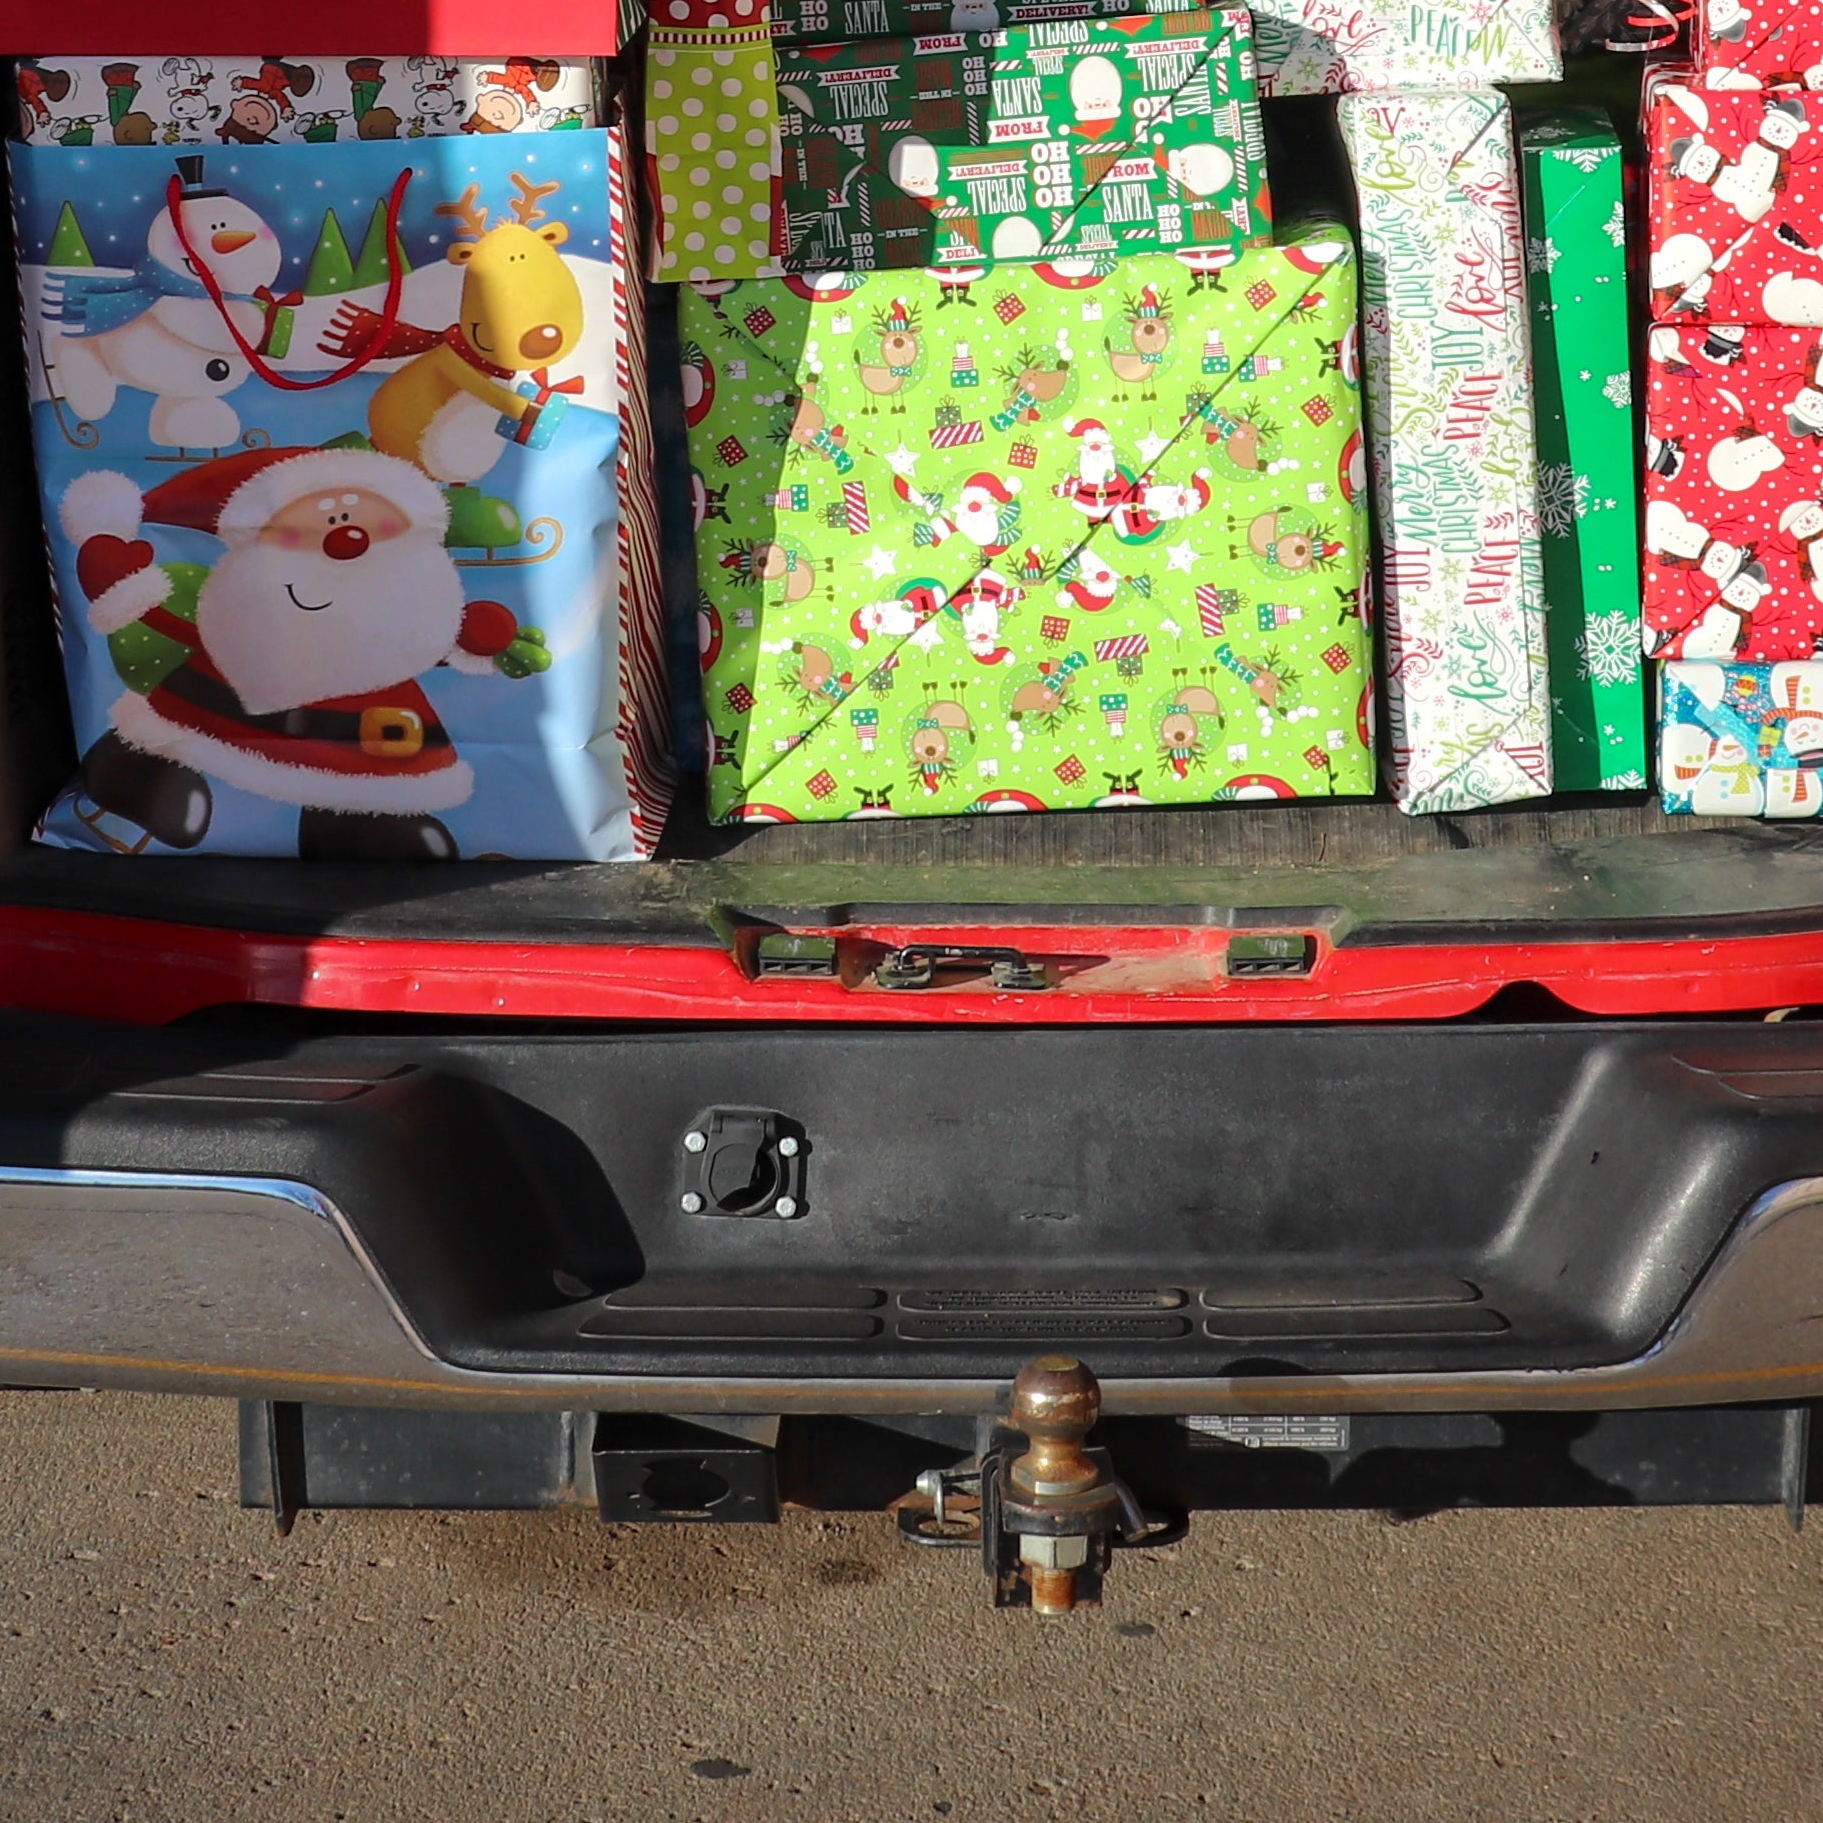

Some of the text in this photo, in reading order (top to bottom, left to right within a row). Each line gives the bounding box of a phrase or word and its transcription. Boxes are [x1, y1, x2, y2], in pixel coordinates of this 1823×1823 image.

[800, 0, 828, 16] HO
[1015, 4, 1089, 19] DELIVERY!
[801, 16, 829, 32] HO
[845, 0, 890, 35] SANTA
[919, 35, 962, 50] FROM
[979, 32, 1009, 48] HO
[1133, 40, 1201, 55] DELIVERY!
[962, 56, 986, 69] HO
[1239, 51, 1257, 80] HO
[824, 68, 892, 83] DELIVERY!
[963, 69, 987, 82] HO
[965, 82, 988, 96] HO
[991, 77, 1042, 117] SANTA
[829, 82, 889, 120] SPECIAL
[790, 112, 803, 136] HO
[995, 121, 1044, 137] FROM
[1031, 141, 1069, 163] HO
[956, 162, 1020, 177] DELIVERY!
[1033, 164, 1072, 186] HO
[1110, 162, 1150, 178] ROM
[967, 177, 1026, 216] SPECIAL
[1035, 186, 1074, 208] HO
[1102, 183, 1153, 223] SANTA
[1157, 204, 1180, 218] HO
[1158, 217, 1181, 230] HO
[851, 232, 873, 245] HO
[1160, 230, 1183, 244] HO
[852, 245, 874, 258] HO
[853, 257, 876, 270] HO
[1444, 251, 1507, 329] love
[1430, 319, 1485, 372] JOY
[1442, 369, 1505, 440] PEACE
[1390, 455, 1439, 548] Merry
[1463, 536, 1521, 606] PEACE
[1447, 635, 1509, 716] love
